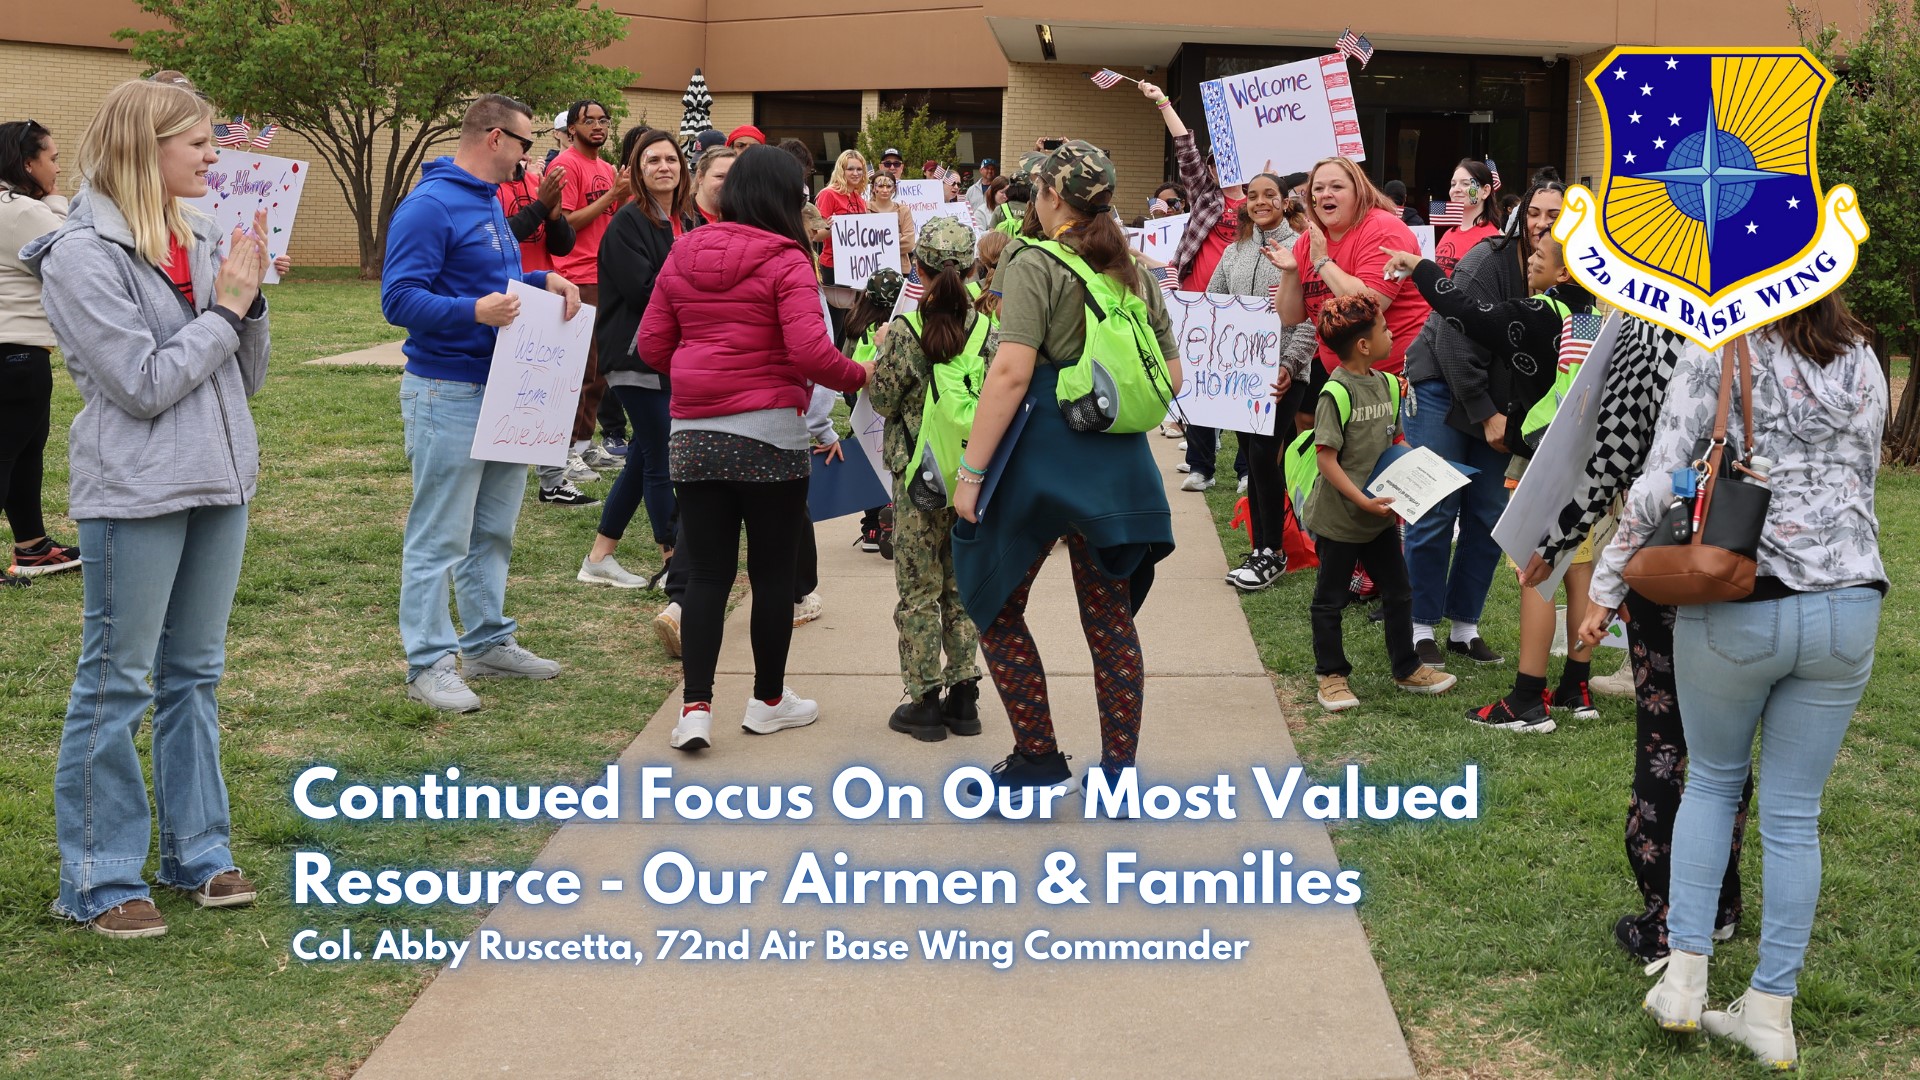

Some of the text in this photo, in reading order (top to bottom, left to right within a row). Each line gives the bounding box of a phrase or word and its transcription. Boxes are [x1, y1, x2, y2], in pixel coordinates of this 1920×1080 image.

[1228, 73, 1312, 109] Welcome
[1254, 102, 1306, 128] Home
[901, 200, 938, 212] DPARTMENT
[834, 219, 894, 254] Welcome
[514, 323, 565, 367] Welcome
[1349, 401, 1394, 423] DEPLOY
